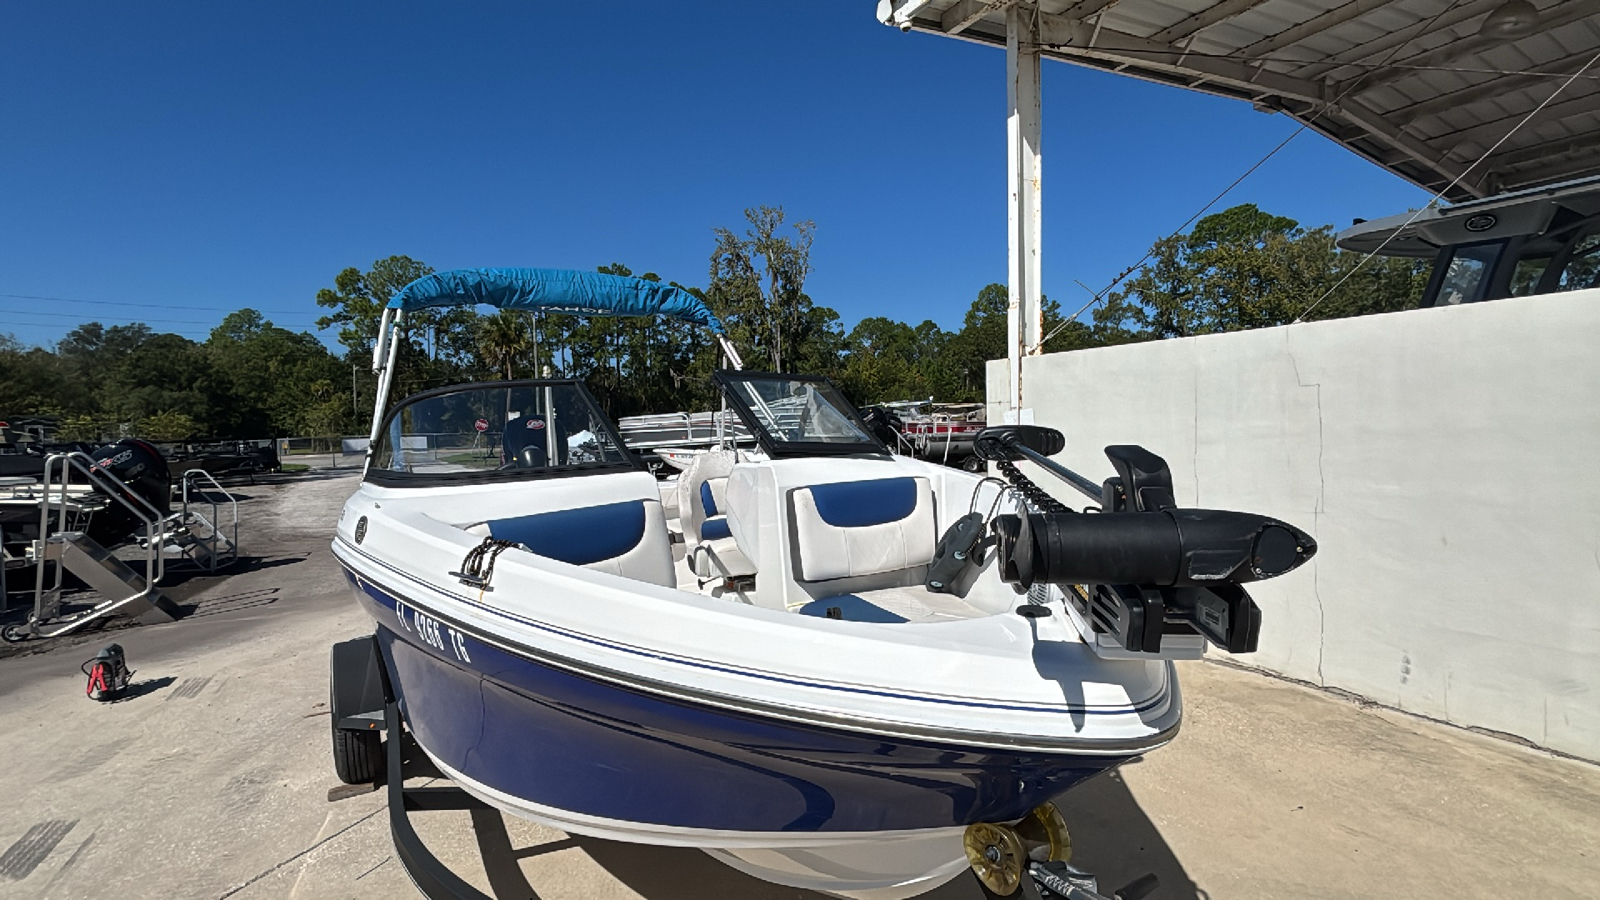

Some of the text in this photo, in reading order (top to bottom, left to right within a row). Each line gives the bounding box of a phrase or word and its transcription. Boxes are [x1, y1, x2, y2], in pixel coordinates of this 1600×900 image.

[396, 601, 471, 663] FL 9266 TG
